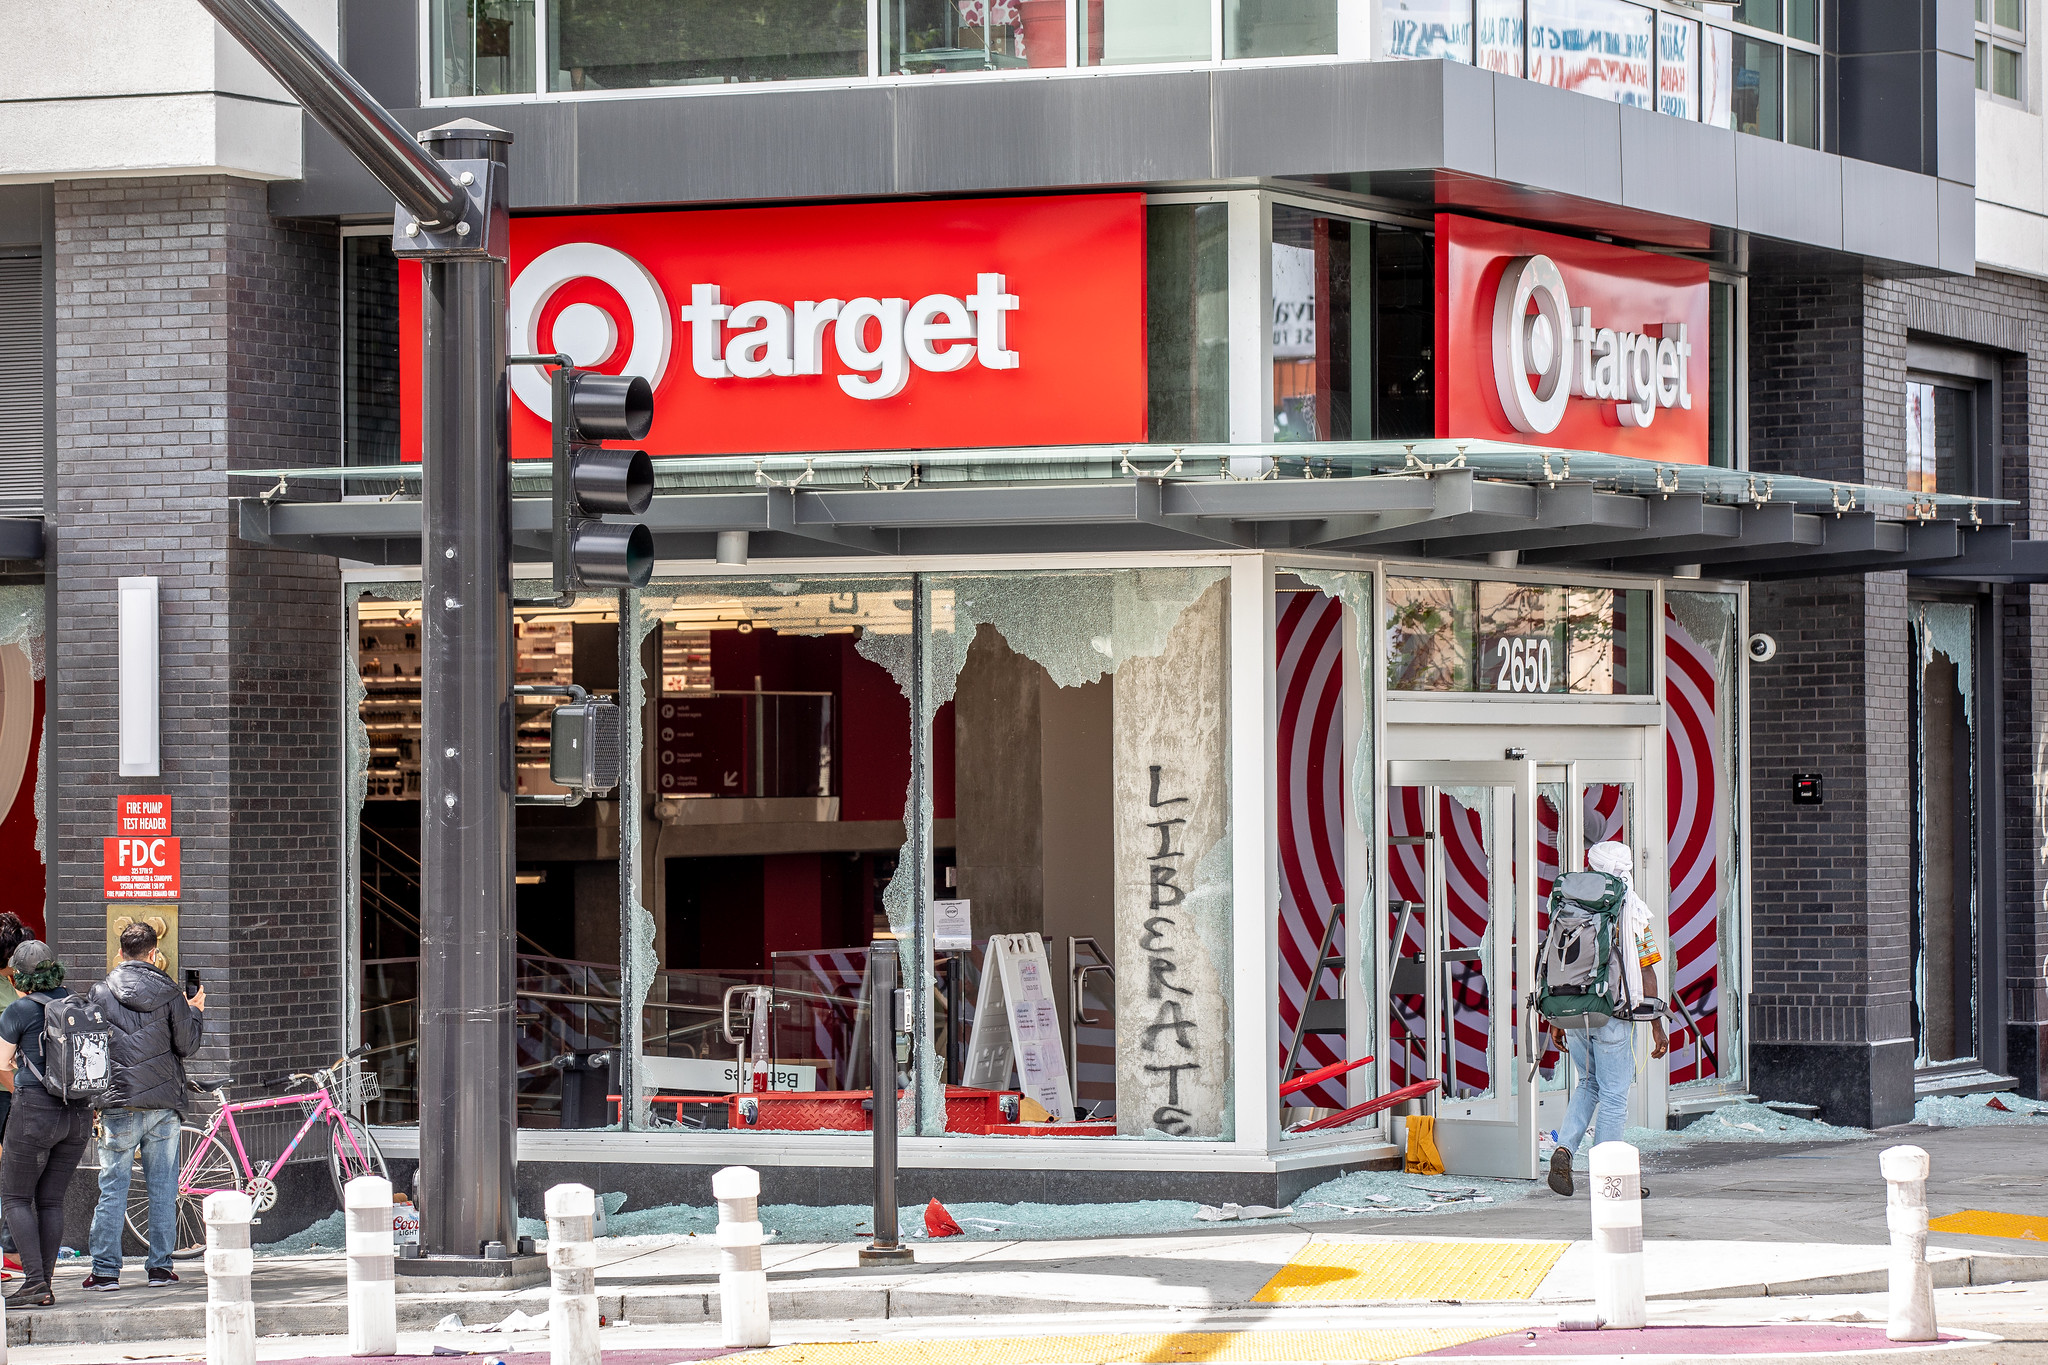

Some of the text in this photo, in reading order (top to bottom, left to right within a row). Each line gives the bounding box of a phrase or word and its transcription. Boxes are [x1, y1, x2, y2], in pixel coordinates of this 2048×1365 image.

[682, 272, 1020, 400] target
[1571, 306, 1692, 428] target
[1497, 637, 1552, 693] 2650
[123, 817, 167, 829] TEST HEADER
[126, 802, 163, 814] FIRE PUMP
[119, 839, 165, 866] FDC
[1140, 765, 1200, 1136] LIBERATE
[393, 1216, 419, 1230] Coor
